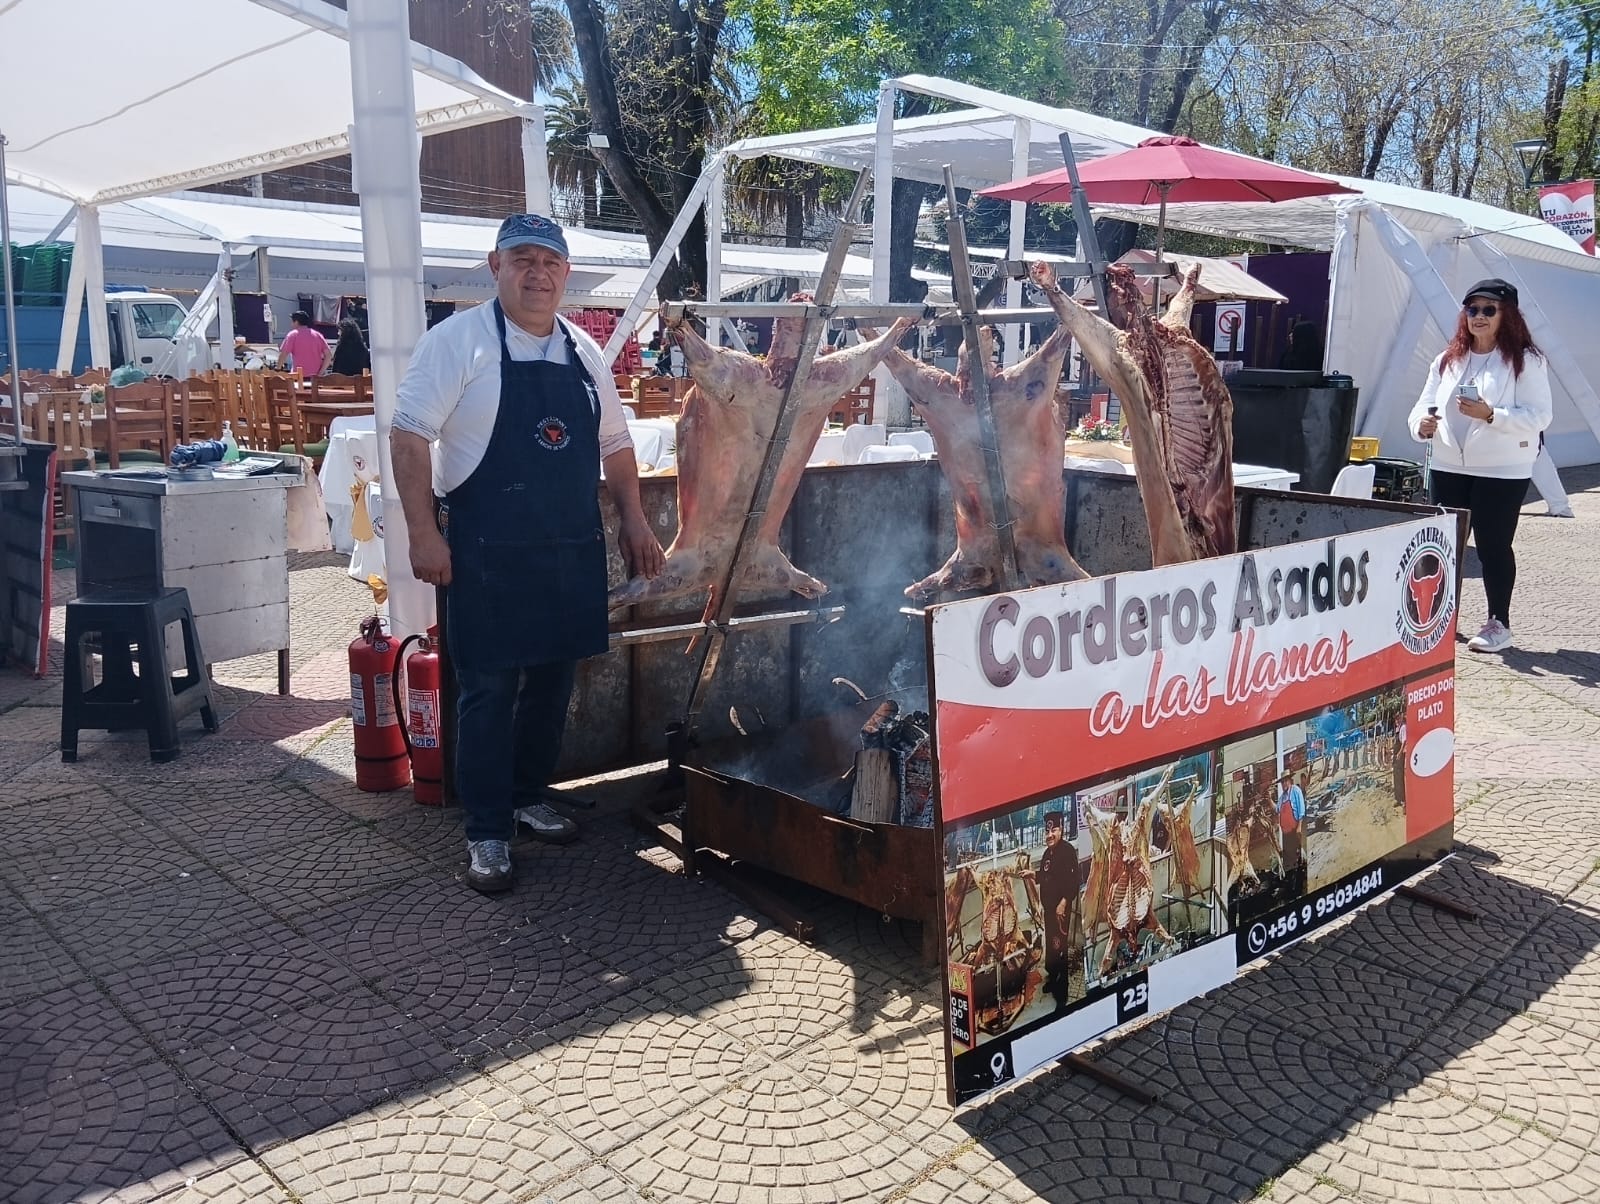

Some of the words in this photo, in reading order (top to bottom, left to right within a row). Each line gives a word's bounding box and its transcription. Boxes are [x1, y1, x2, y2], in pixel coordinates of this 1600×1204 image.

[1565, 227, 1593, 236] ETÓN
[1399, 526, 1454, 573] RESTAURANT
[979, 577, 1217, 689] Corderos
[1230, 537, 1370, 633] Asados
[1089, 690, 1132, 738] a
[1141, 648, 1218, 730] las
[1224, 626, 1354, 706] llamas
[1407, 684, 1437, 706] PRECIO
[1437, 676, 1454, 695] POR
[1417, 700, 1444, 722] PLATO
[1268, 911, 1298, 939] +56
[1301, 904, 1312, 925] 9
[1315, 867, 1382, 918] 95034841
[951, 968, 967, 992] AS
[951, 1007, 963, 1020] DO
[958, 999, 968, 1011] DE
